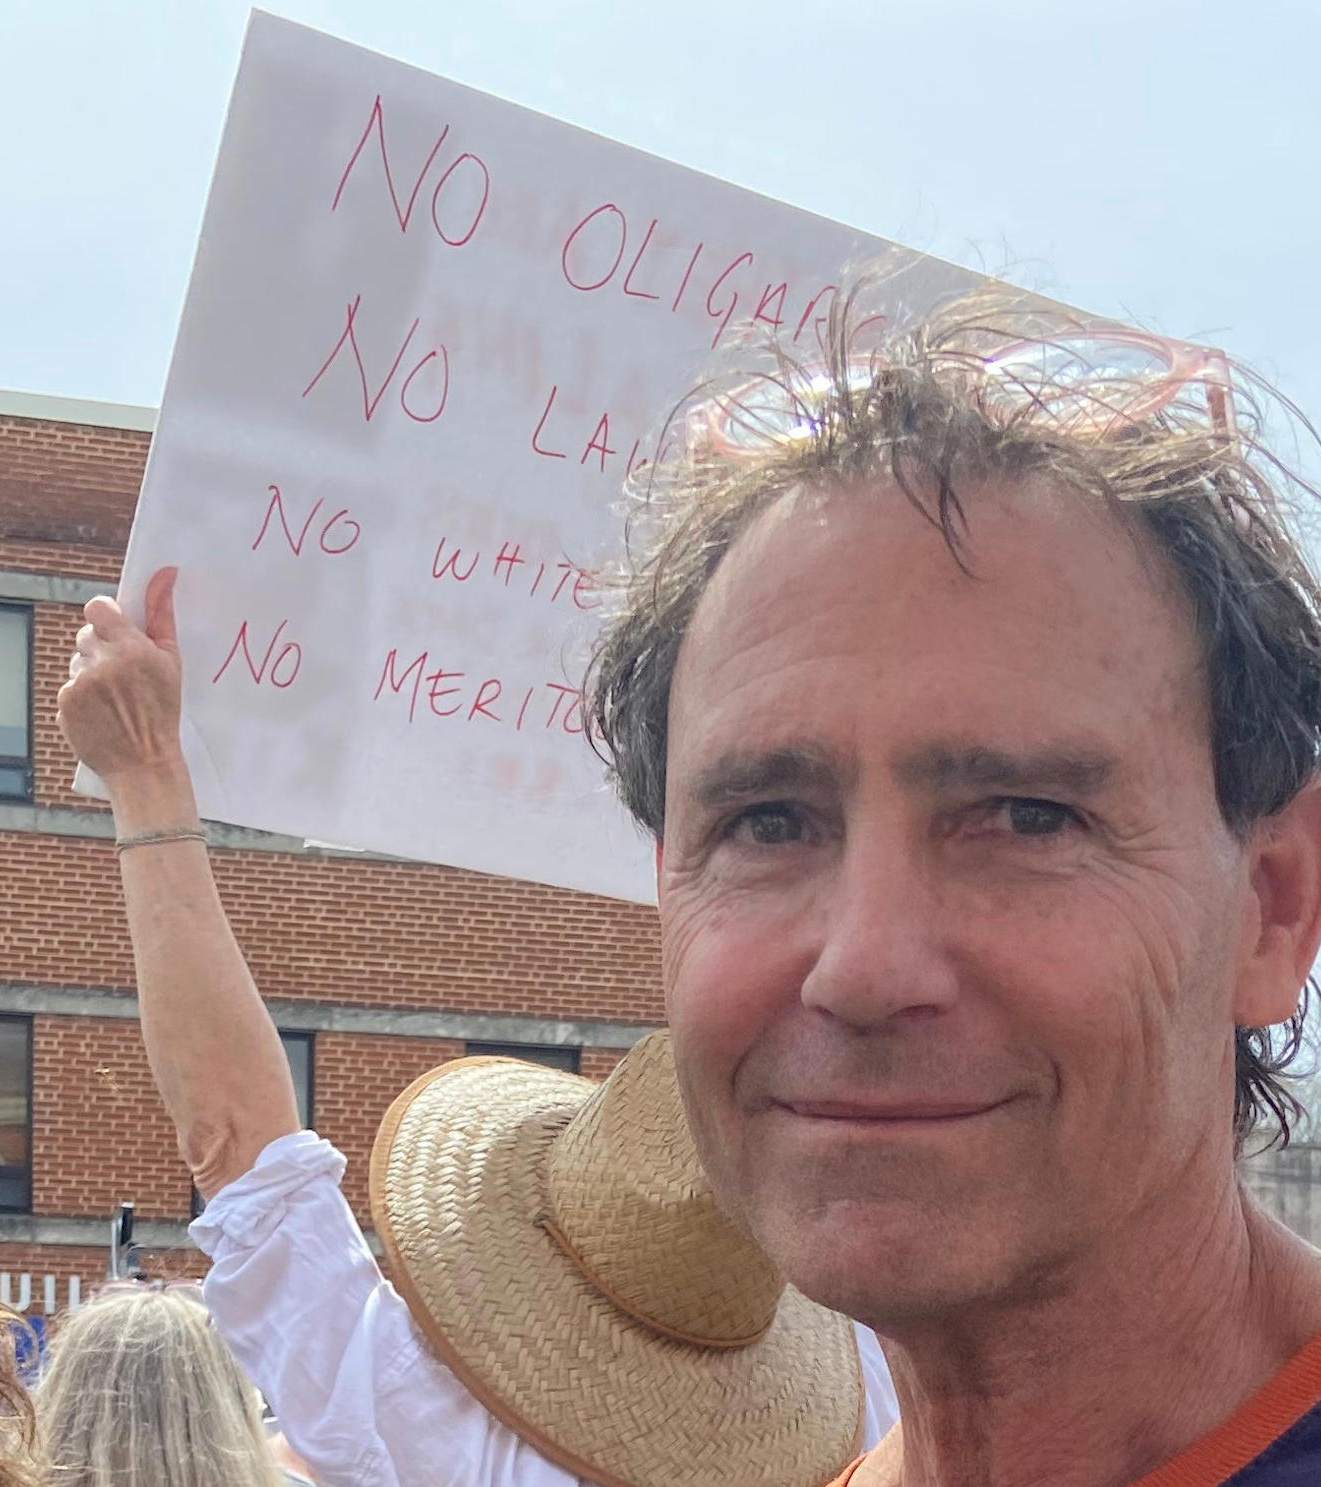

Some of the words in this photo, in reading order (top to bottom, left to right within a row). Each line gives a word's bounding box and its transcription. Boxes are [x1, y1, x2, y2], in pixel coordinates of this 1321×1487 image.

[331, 94, 490, 247] NO
[301, 294, 449, 423] NO
[252, 484, 361, 557] NO
[431, 536, 604, 611] WHITE
[212, 619, 304, 689] NO
[374, 649, 603, 740] MERITO
